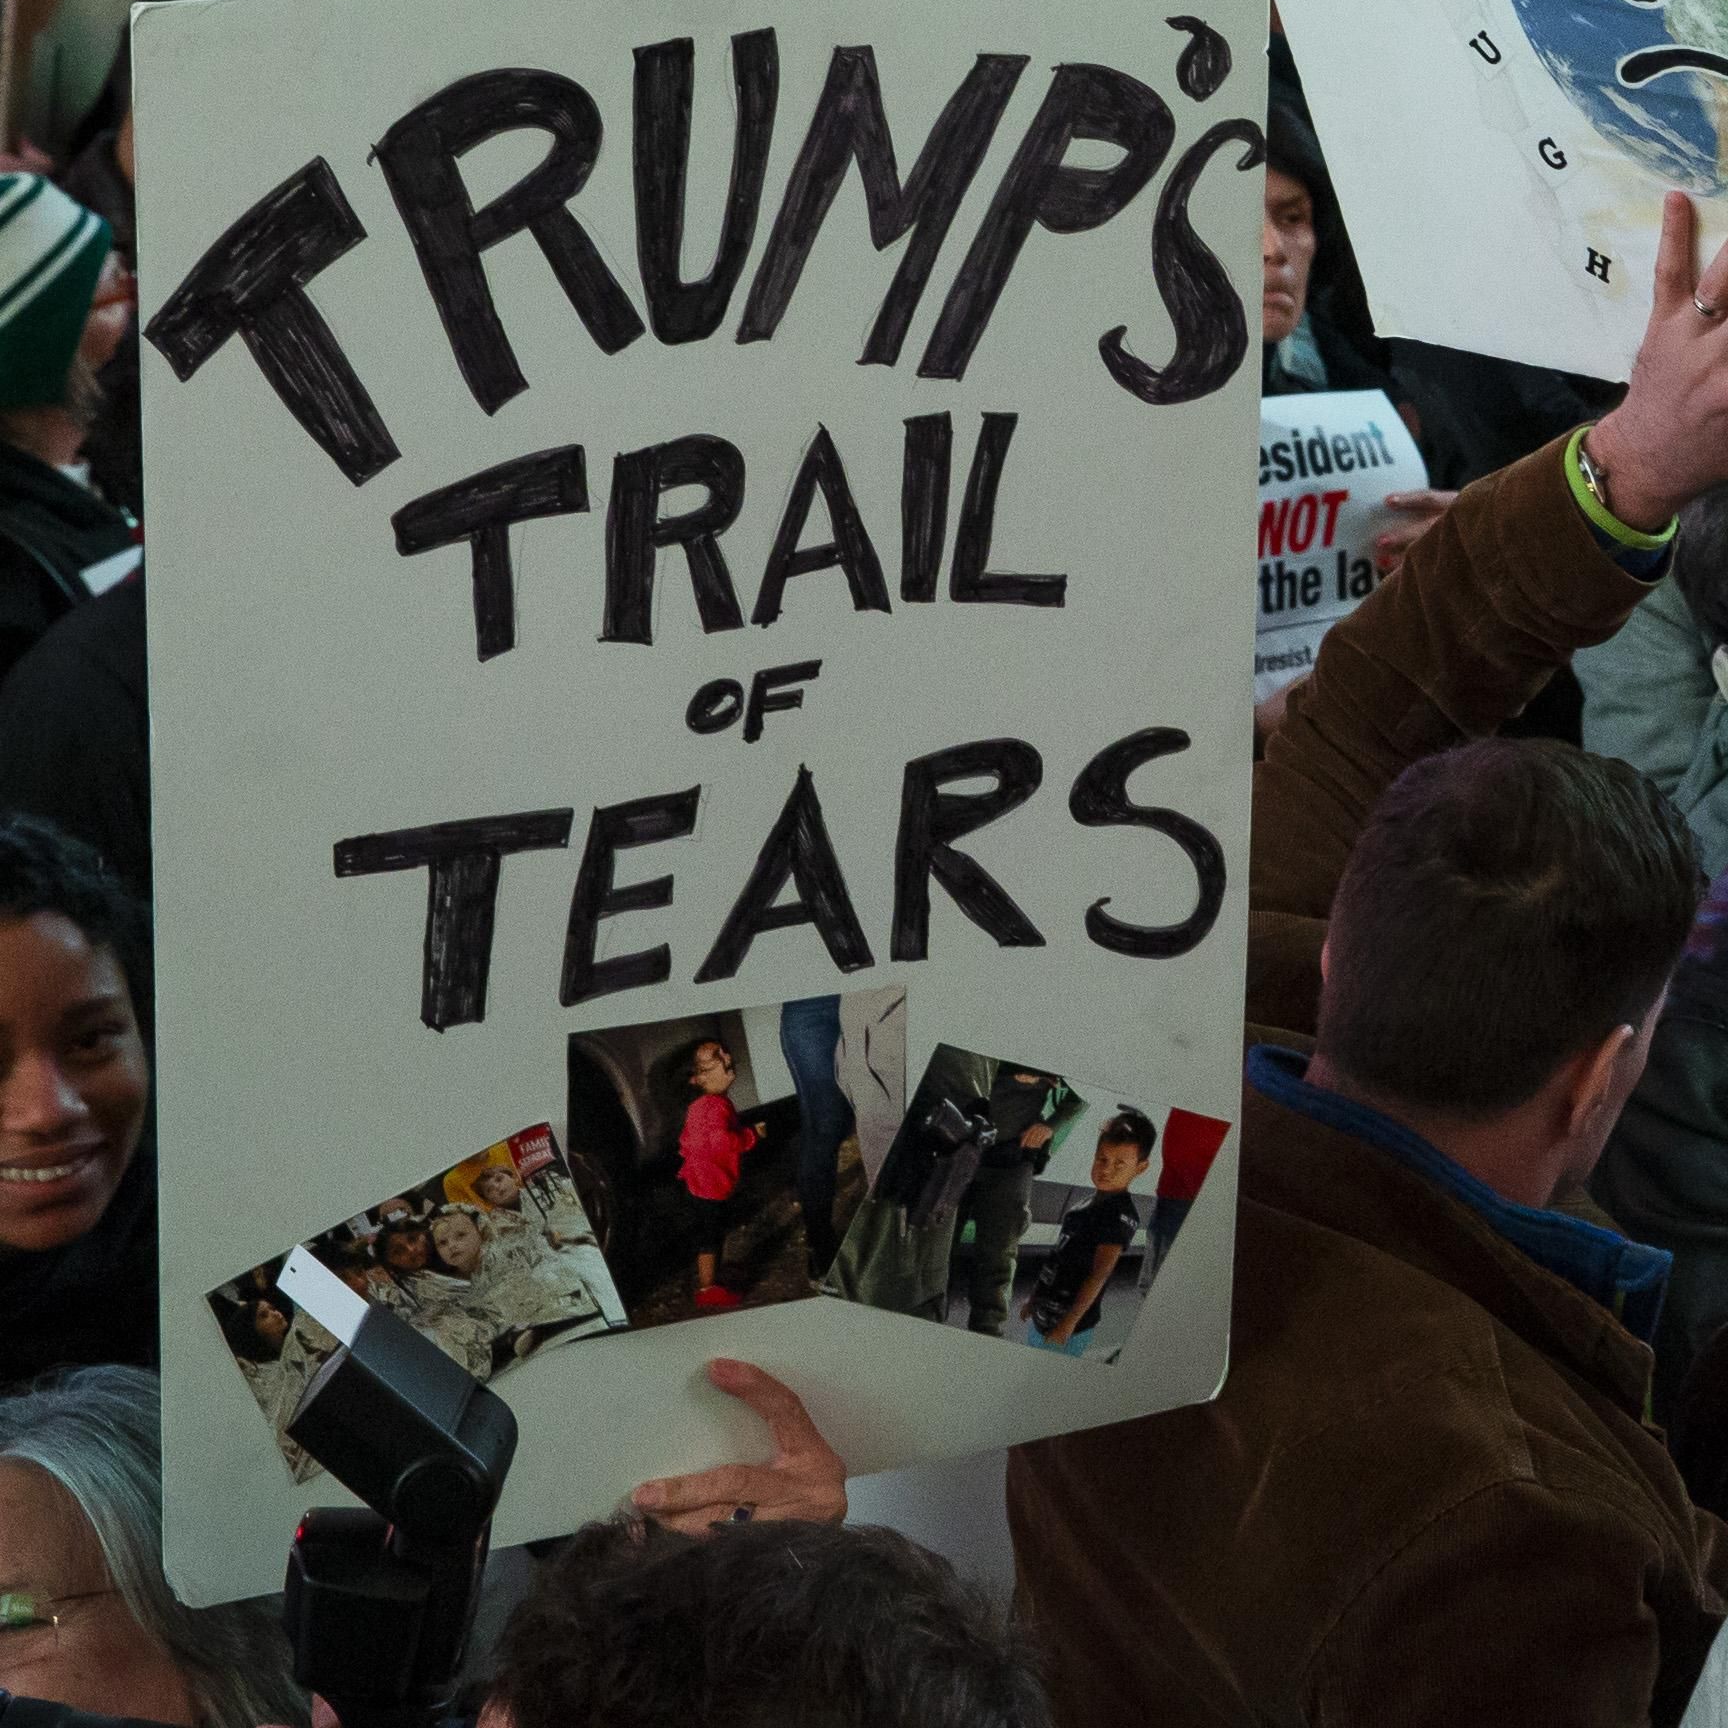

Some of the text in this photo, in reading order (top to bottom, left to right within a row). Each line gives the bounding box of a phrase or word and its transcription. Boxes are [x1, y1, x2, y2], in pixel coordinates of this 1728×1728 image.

[142, 16, 1267, 488] TRUMP'S
[1258, 422, 1394, 486] esident
[391, 410, 1067, 662] TRAIL
[1258, 488, 1348, 560] NOT
[1260, 548, 1385, 615] the la
[685, 658, 823, 743] OF
[332, 726, 1228, 1032] TEARS
